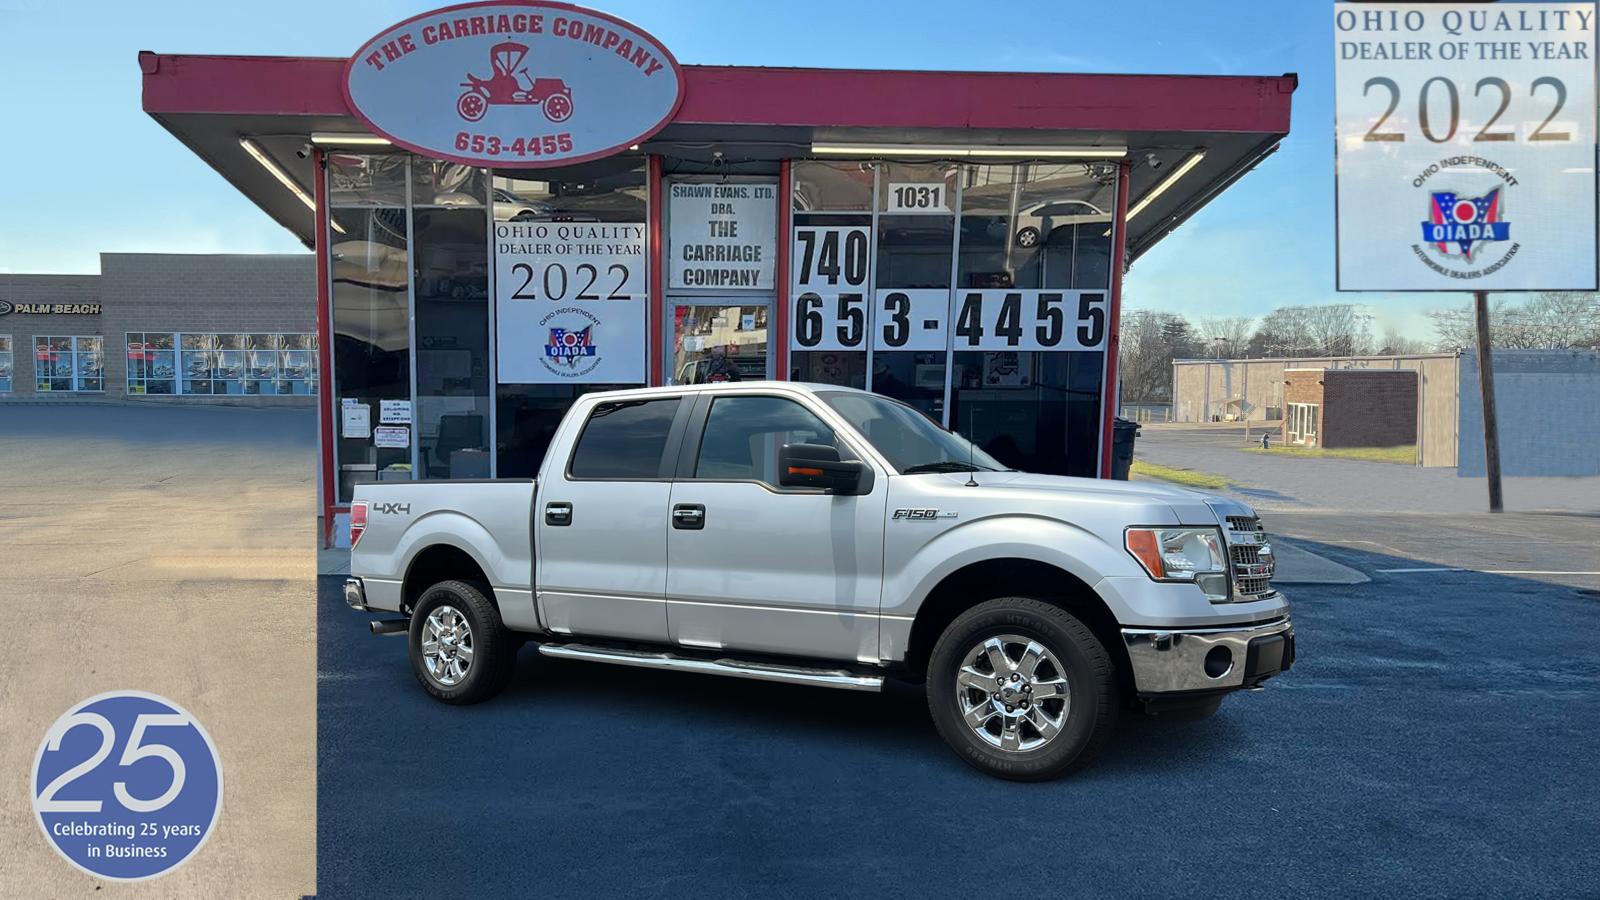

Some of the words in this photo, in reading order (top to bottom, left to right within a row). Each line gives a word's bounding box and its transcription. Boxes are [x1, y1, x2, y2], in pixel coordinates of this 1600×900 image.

[1336, 10, 1425, 31] OHIO
[1442, 10, 1592, 35] QUALITY
[365, 33, 417, 72] THE
[421, 14, 543, 45] CARRIAGE
[552, 16, 664, 77] COMPANY
[1340, 42, 1432, 60] DEALER
[1438, 42, 1469, 60] OF
[1475, 42, 1522, 60] THE
[1529, 42, 1589, 60] YEAR
[1363, 76, 1571, 143] 2022
[455, 132, 573, 156] 653-4455
[1412, 164, 1440, 188] OHIO
[1440, 155, 1519, 188] INDEPENDENT
[673, 186, 711, 198] SHAWN
[754, 187, 774, 199] LTD.
[894, 186, 940, 208] 1031
[711, 203, 736, 215] DBA.
[497, 226, 548, 239] OHIO
[557, 226, 643, 241] QUALITY
[709, 220, 738, 238] THE
[1432, 224, 1495, 241] OIADA
[499, 243, 552, 254] DEALER
[555, 243, 573, 254] OF
[577, 244, 603, 255] THE
[607, 244, 641, 255] YEAR
[683, 244, 762, 262] CARRIAGE
[797, 230, 868, 286] 740
[1411, 244, 1449, 277] AUTOMOBILE
[1450, 268, 1482, 280] DEALERS
[1483, 242, 1521, 277] ASSOCIATION
[511, 262, 631, 301] 2022
[683, 268, 760, 286] COMPANY
[15, 303, 50, 314] PALM
[54, 304, 100, 314] BEACH
[539, 312, 556, 327] OHIO
[555, 307, 601, 327] INDEPENDENT
[551, 346, 588, 356] OIADA
